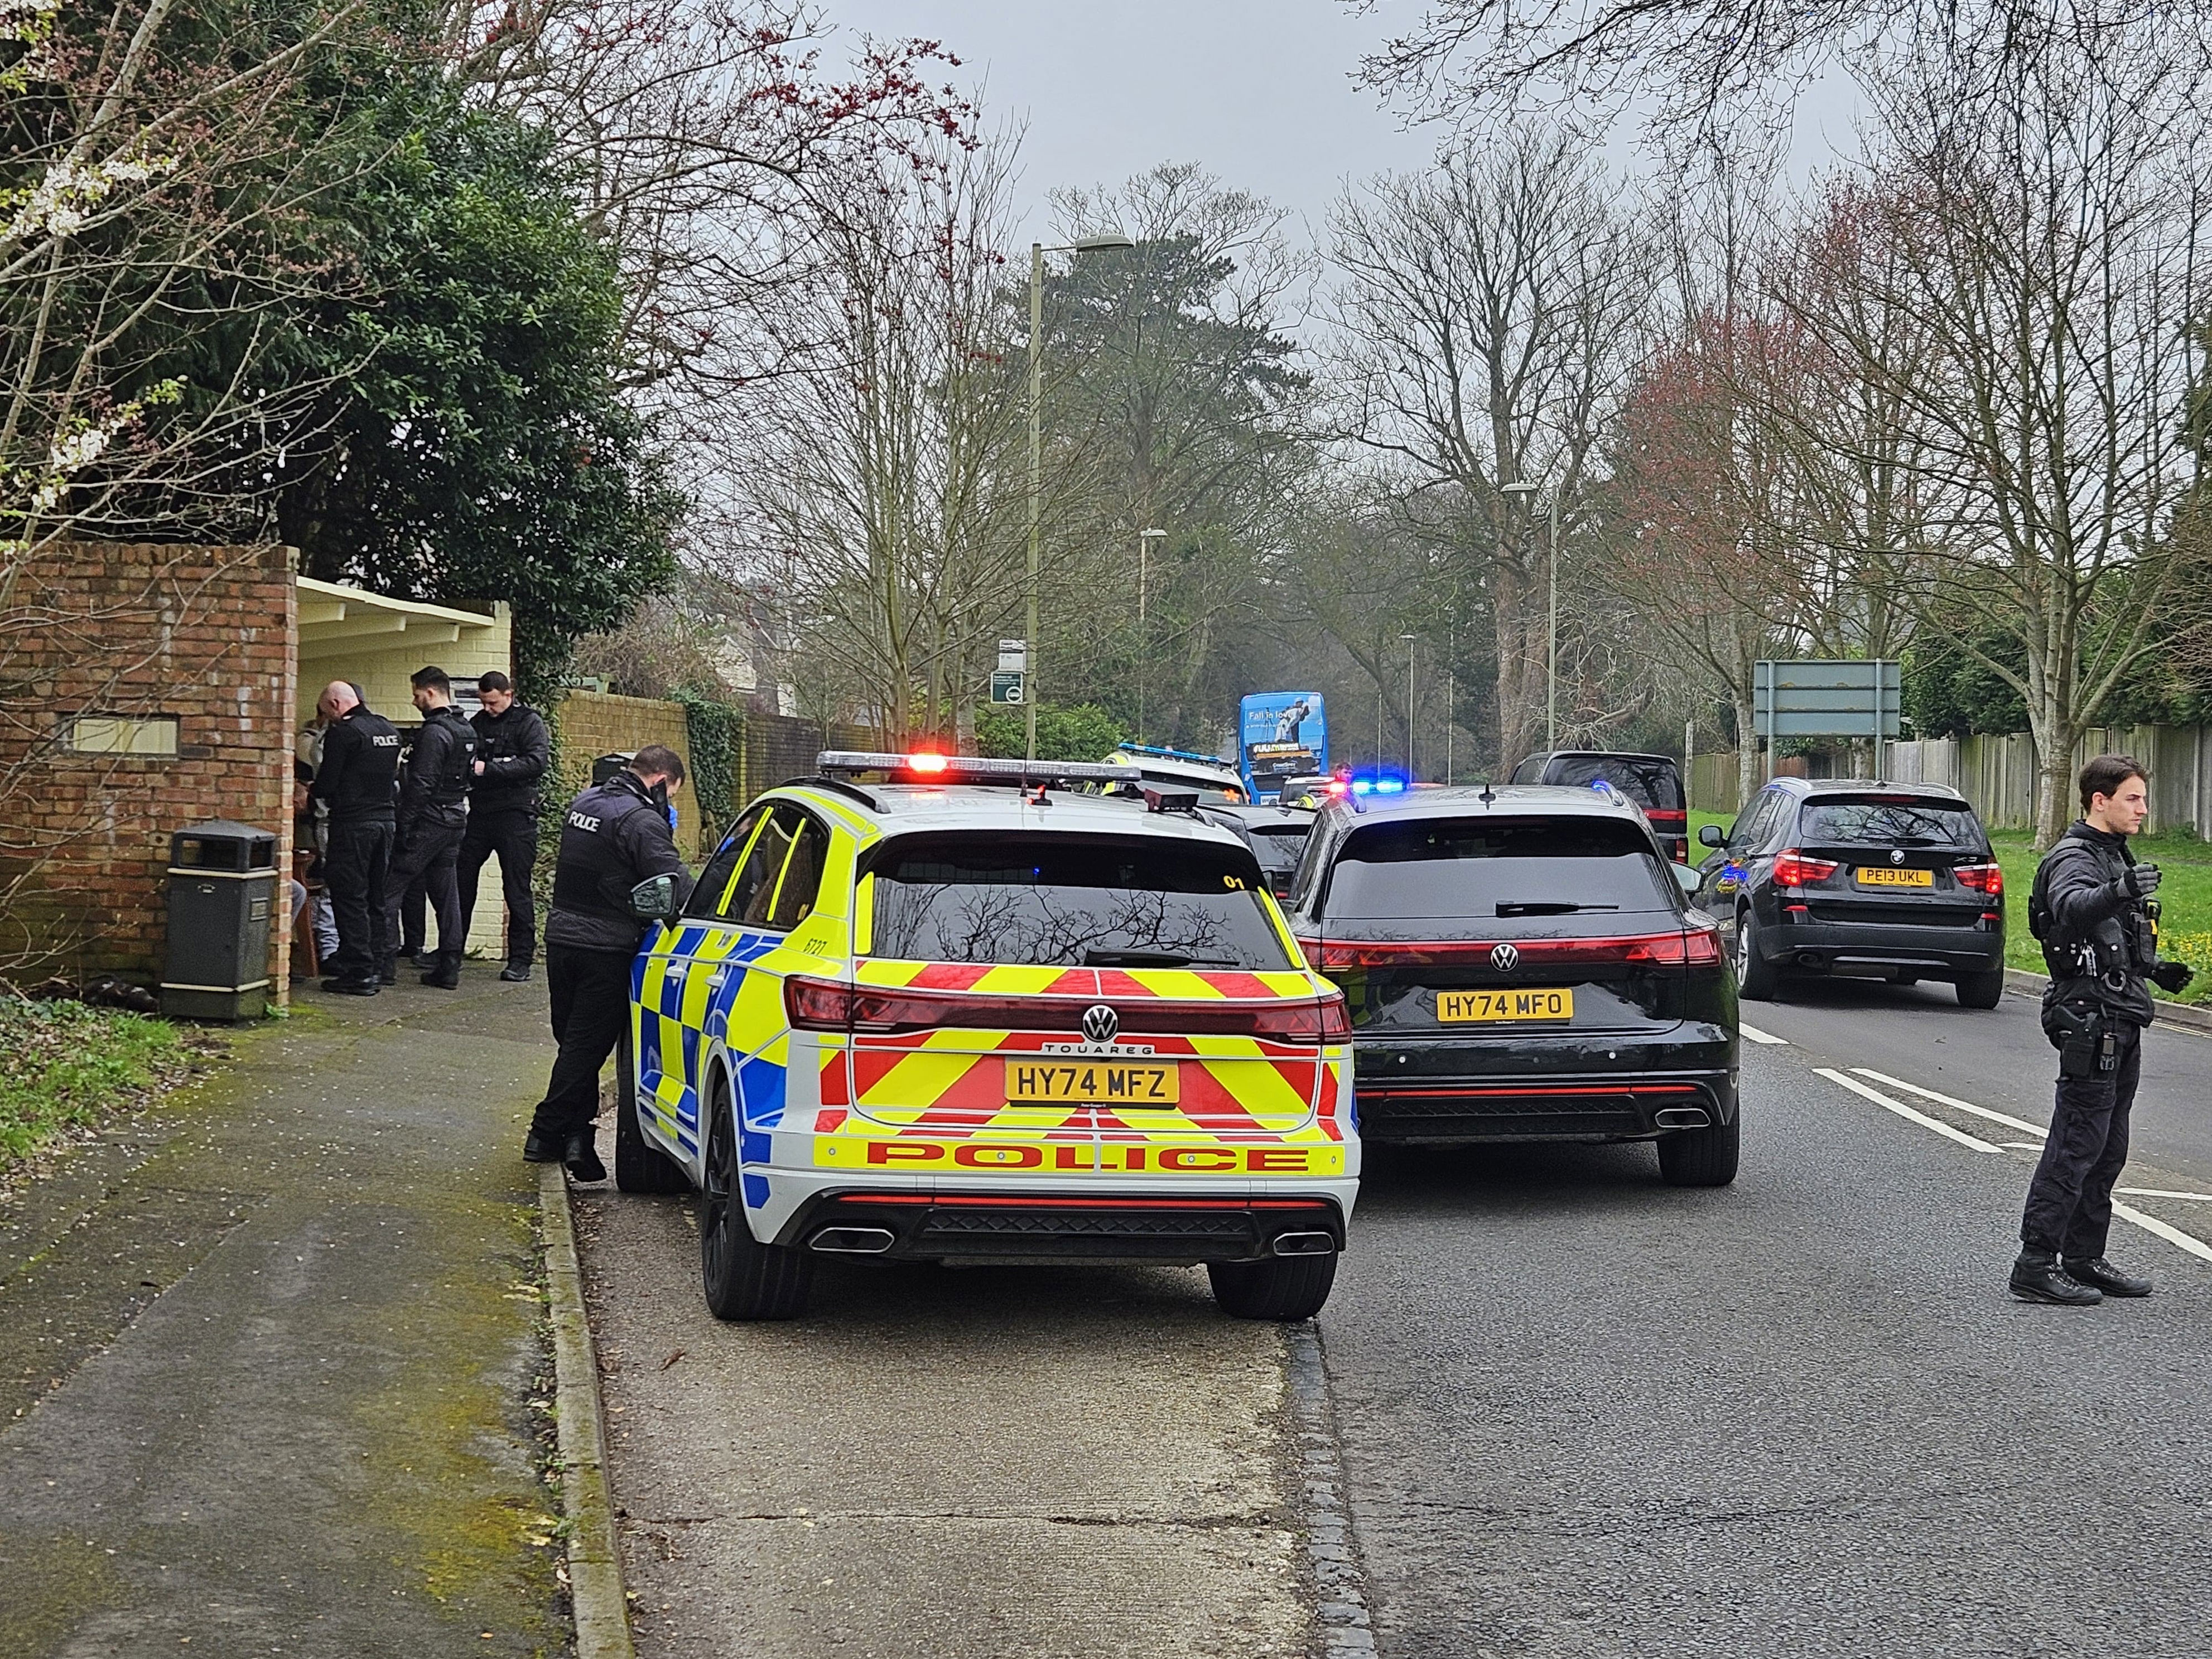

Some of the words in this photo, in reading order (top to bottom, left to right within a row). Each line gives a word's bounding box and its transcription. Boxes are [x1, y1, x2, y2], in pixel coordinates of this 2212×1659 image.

[1249, 711, 1264, 720] Fall
[372, 735, 399, 746] POLICE
[568, 811, 601, 832] POLICE
[1223, 875, 1245, 890] 01
[1867, 869, 1895, 881] PE13
[1898, 871, 1924, 883] UKL
[1446, 995, 1508, 1017] HY74
[1516, 994, 1562, 1015] MFO
[1044, 1044, 1152, 1054] TOUAREG
[1018, 1067, 1097, 1096] HY74
[1107, 1068, 1165, 1097] MFZ
[867, 1142, 1309, 1171] POLICE
